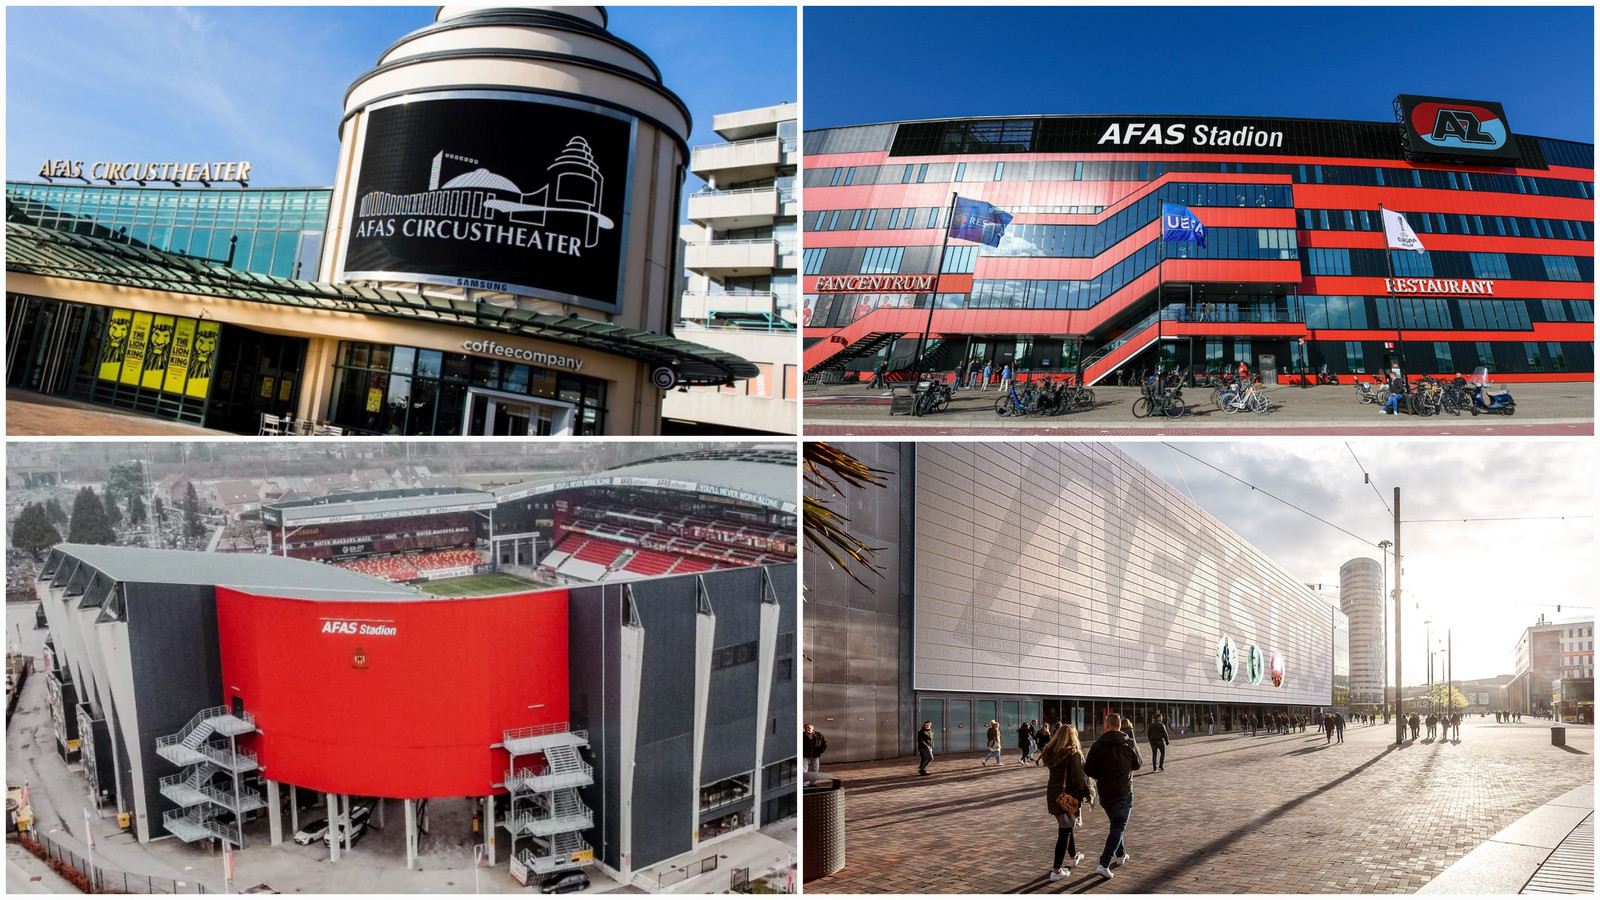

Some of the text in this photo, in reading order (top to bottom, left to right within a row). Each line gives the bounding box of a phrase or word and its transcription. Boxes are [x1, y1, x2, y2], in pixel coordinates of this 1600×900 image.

[1432, 108, 1496, 145] AZ
[1097, 123, 1284, 148] AFAS Stadion
[39, 159, 252, 182] AFAS CIRCUSTHEATER
[1167, 215, 1204, 236] UEFA
[356, 218, 582, 257] AFAS CIRCUSTHEATER
[456, 278, 508, 292] SAMSUNG
[814, 276, 935, 291] FANCENTRUM
[1384, 278, 1494, 295] RESTAURANT
[133, 330, 145, 339] THE
[176, 337, 188, 346] THE
[129, 340, 146, 348] LION
[173, 347, 189, 355] LION
[127, 349, 143, 358] KING
[171, 357, 187, 365] KING
[463, 338, 585, 371] coffeecompany
[719, 488, 739, 498] NEVER
[739, 491, 757, 502] WORK
[757, 495, 778, 507] ALONE
[322, 621, 397, 636] AFAS Stadion
